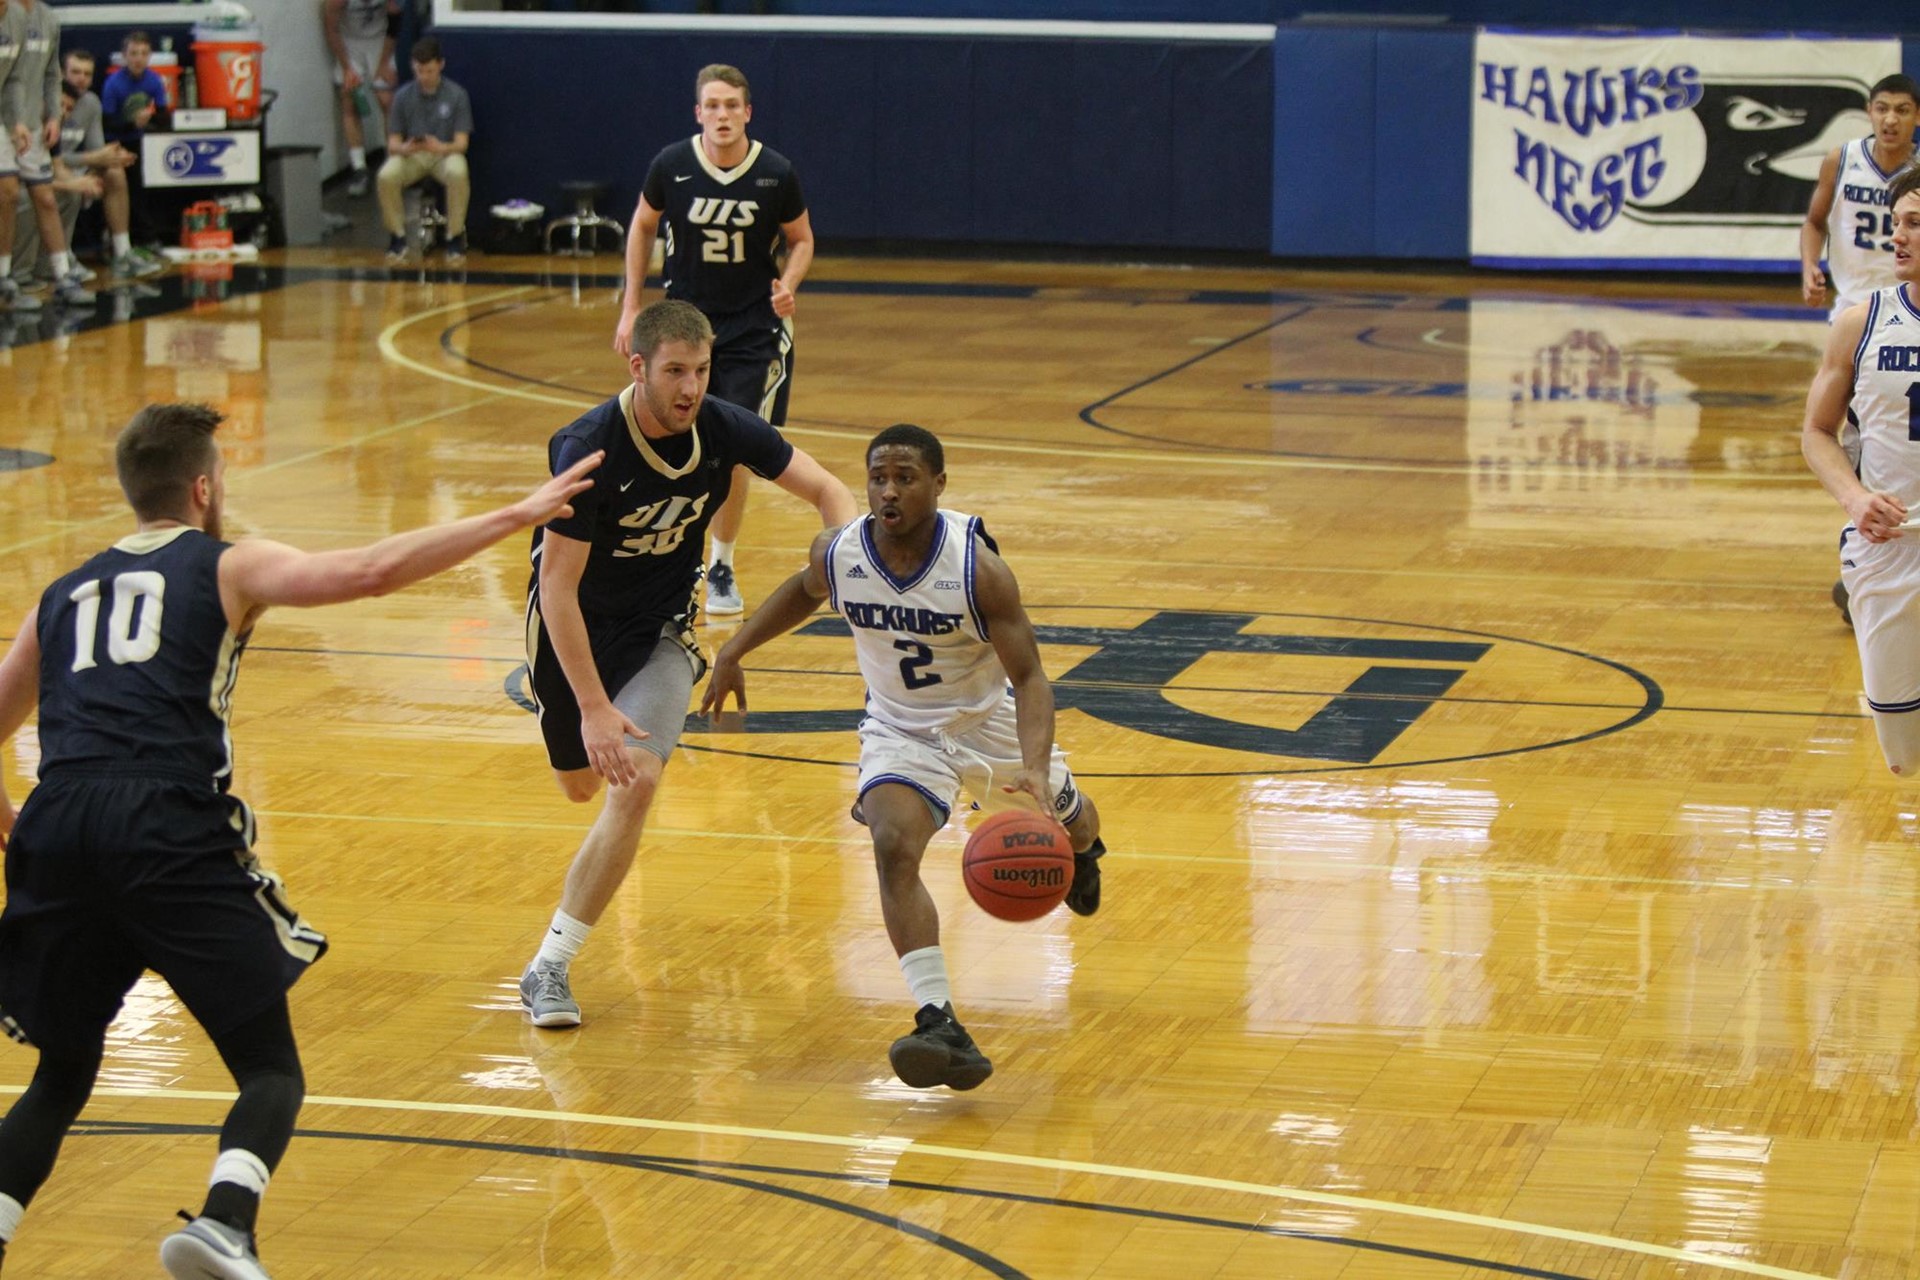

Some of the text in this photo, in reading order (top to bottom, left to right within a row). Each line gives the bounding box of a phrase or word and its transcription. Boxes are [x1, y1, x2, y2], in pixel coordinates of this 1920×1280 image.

[1480, 62, 1703, 137] HAWKS
[1513, 127, 1667, 232] NEST
[687, 197, 760, 227] UIS
[702, 229, 746, 263] 21
[612, 525, 684, 557] 30
[69, 571, 166, 672] 10
[843, 601, 964, 635] ROCKHURST
[893, 639, 943, 690] 2
[1003, 831, 1054, 848] NCAA
[993, 866, 1064, 888] Wilson
